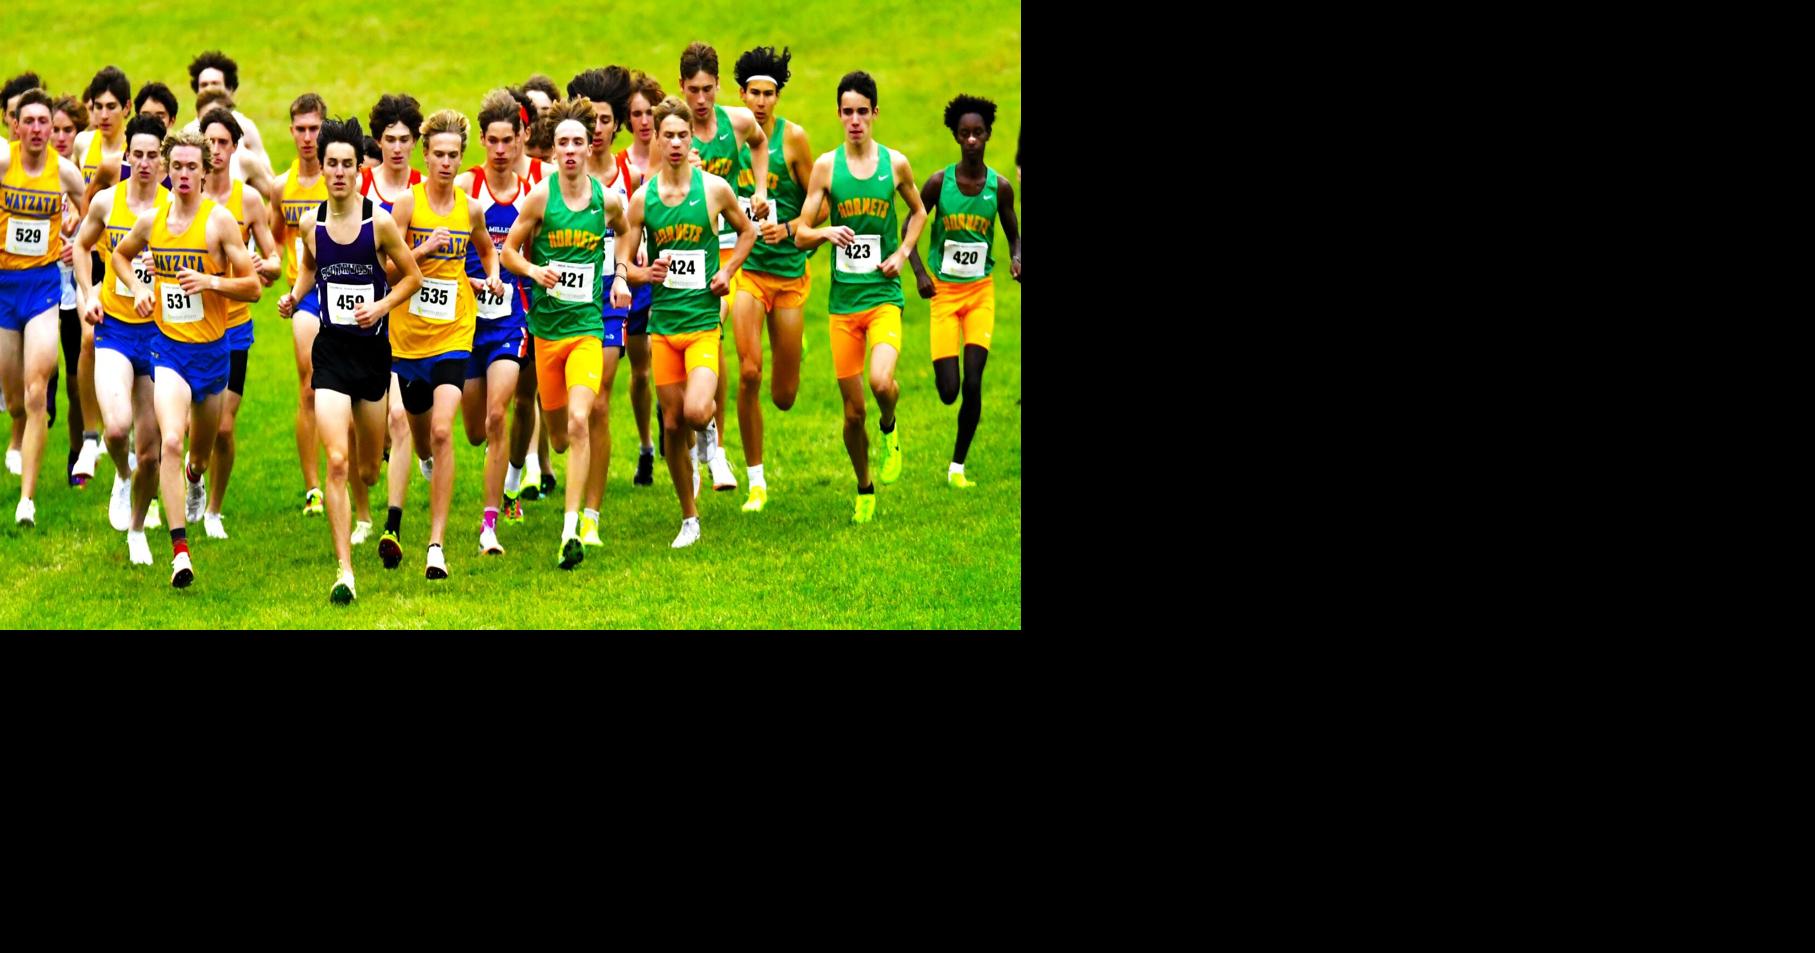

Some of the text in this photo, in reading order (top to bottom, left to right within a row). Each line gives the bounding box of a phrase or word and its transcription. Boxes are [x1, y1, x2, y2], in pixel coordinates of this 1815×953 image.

[4, 191, 57, 214] WAYZATA
[837, 196, 890, 219] HORNETS
[943, 212, 991, 235] HORNETS
[15, 228, 42, 244] 529
[844, 243, 871, 260] 423
[952, 250, 979, 266] 420
[669, 259, 696, 275] 424
[134, 268, 153, 284] 28
[558, 271, 585, 289] 421
[166, 293, 191, 309] 531
[419, 287, 448, 306] 535
